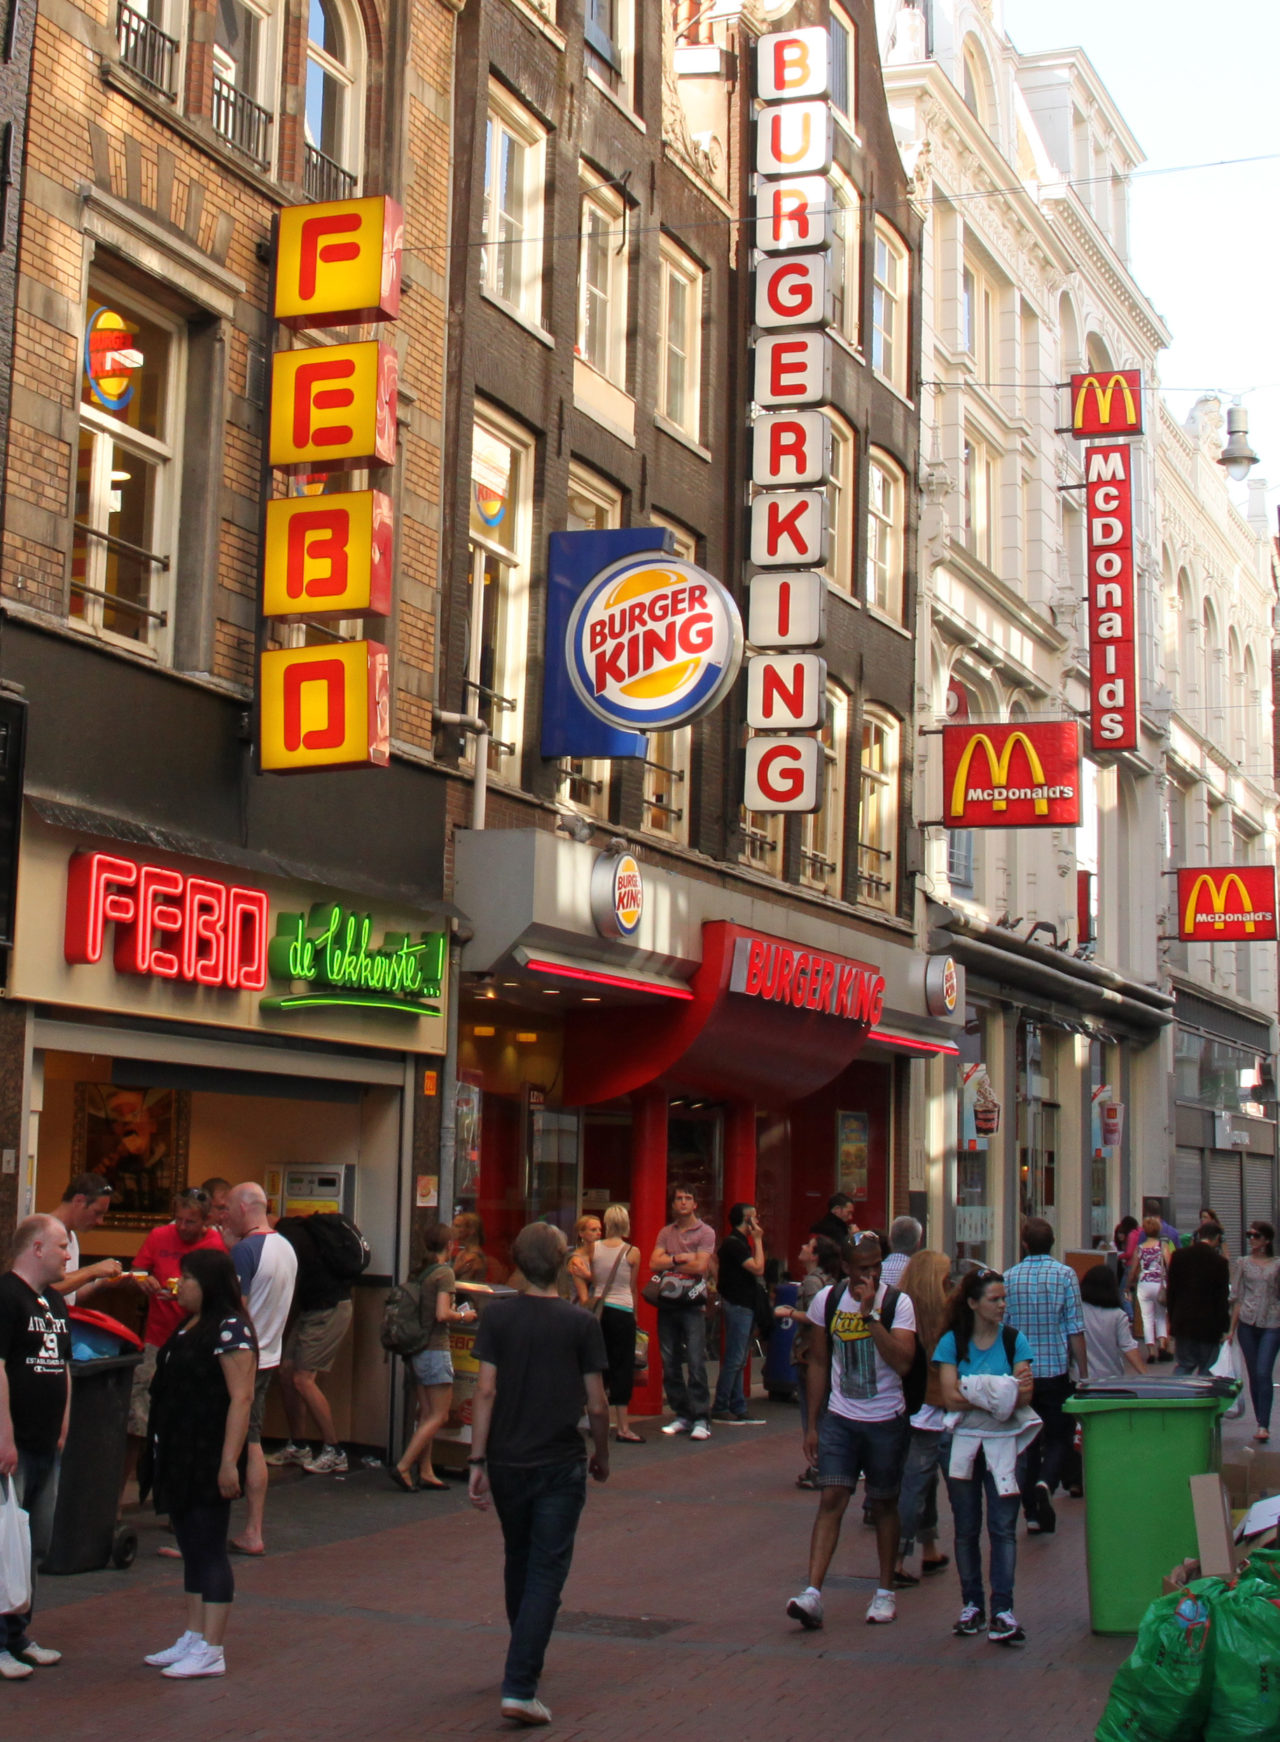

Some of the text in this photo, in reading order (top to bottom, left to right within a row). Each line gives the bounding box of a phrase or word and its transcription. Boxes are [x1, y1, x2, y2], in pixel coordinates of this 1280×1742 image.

[756, 37, 813, 803] BURGER KING
[283, 212, 363, 753] FEBO
[589, 585, 708, 653] BURGER
[594, 612, 714, 697] KING
[967, 785, 1074, 801] McDonald's
[70, 851, 270, 993] FEBO
[289, 918, 316, 978] de
[616, 888, 642, 911] KING
[1195, 911, 1273, 923] McDonald's
[744, 938, 886, 1026] BURGER KING
